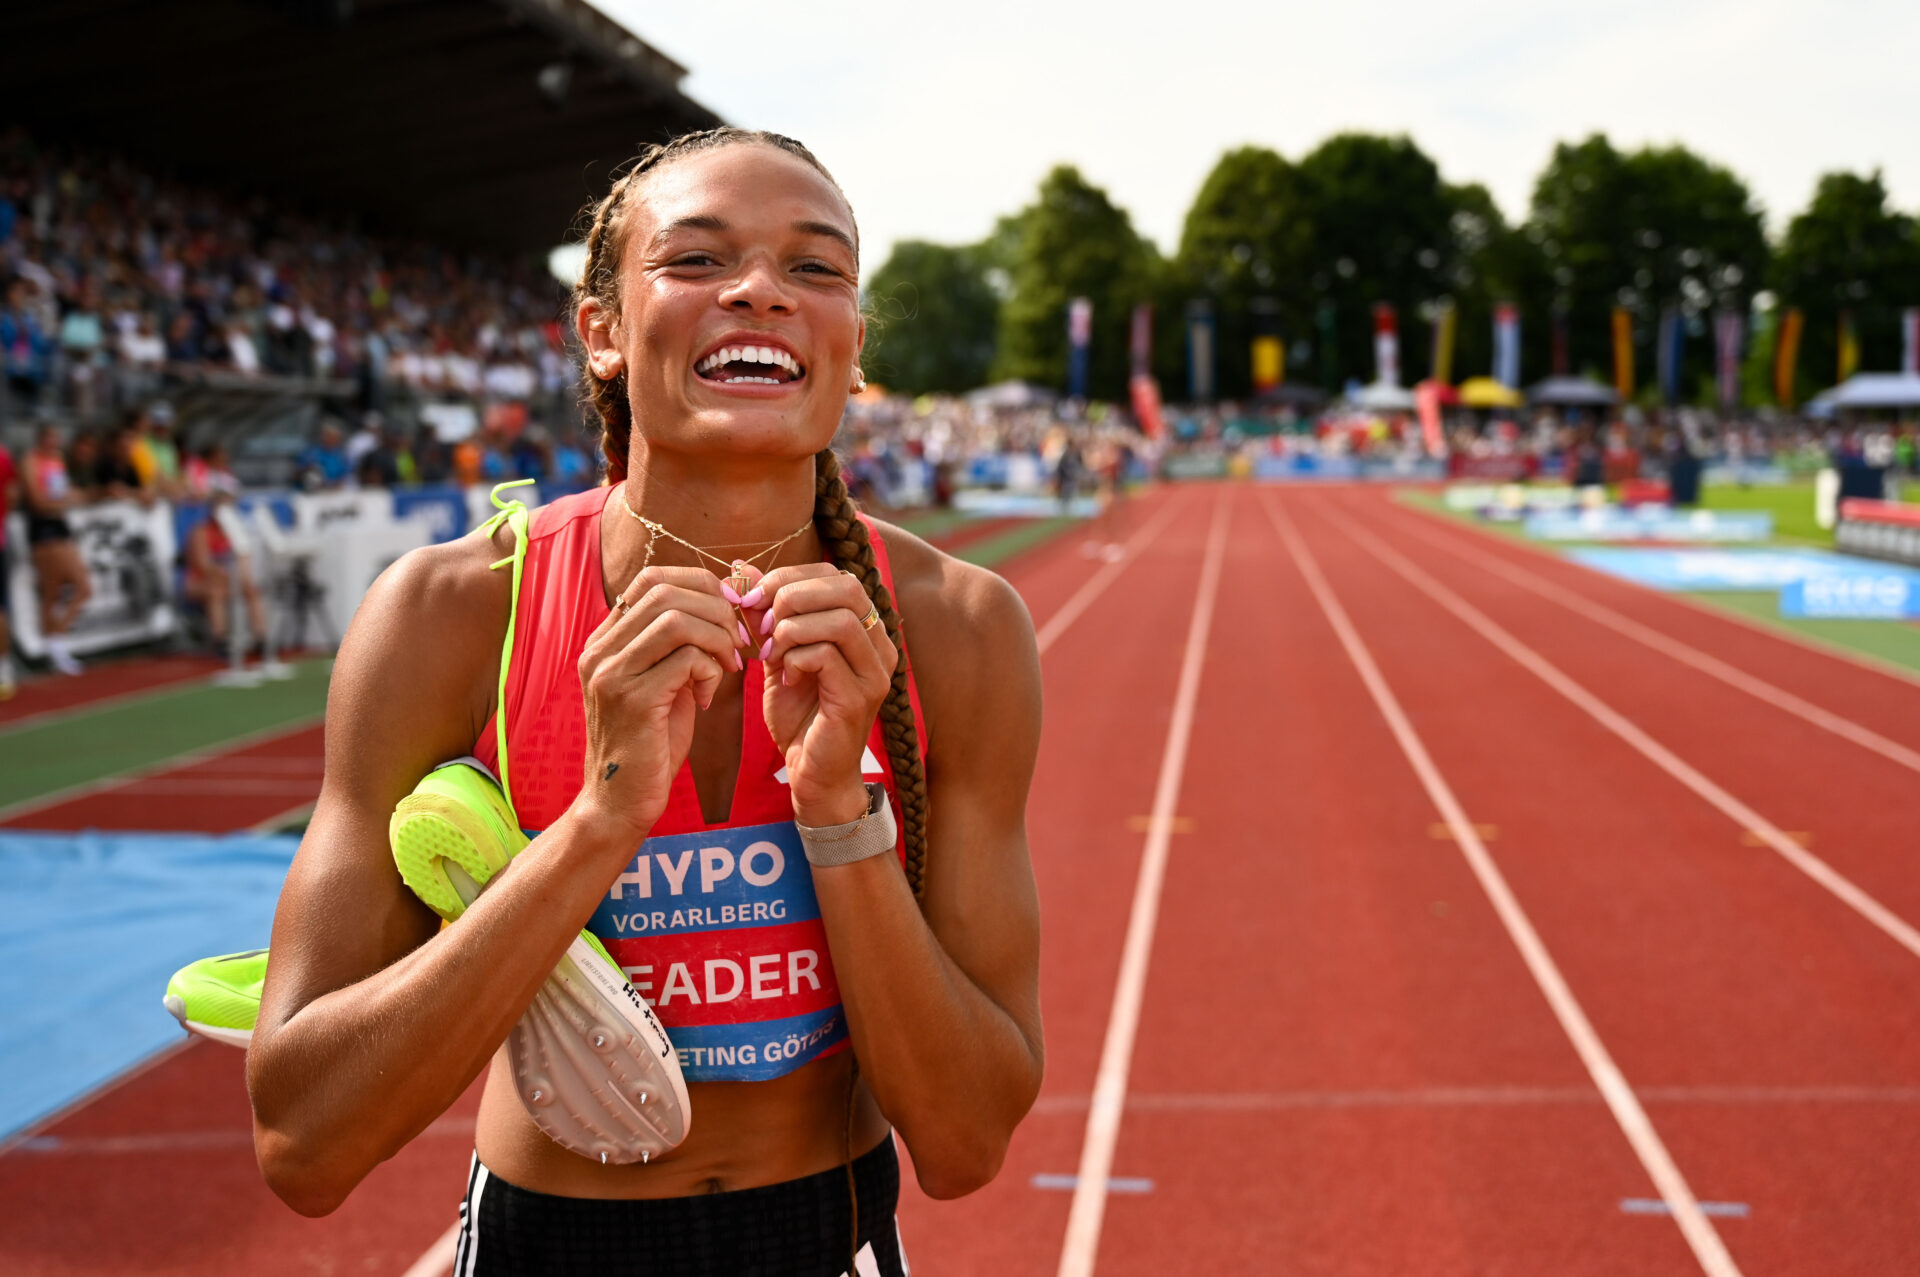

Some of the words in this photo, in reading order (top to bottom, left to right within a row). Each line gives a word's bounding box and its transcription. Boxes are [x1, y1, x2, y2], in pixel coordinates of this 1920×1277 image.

[610, 841, 786, 900] HYPO
[611, 899, 787, 933] VORARLBERG
[621, 949, 822, 1008] EADER
[674, 1045, 757, 1067] ETING
